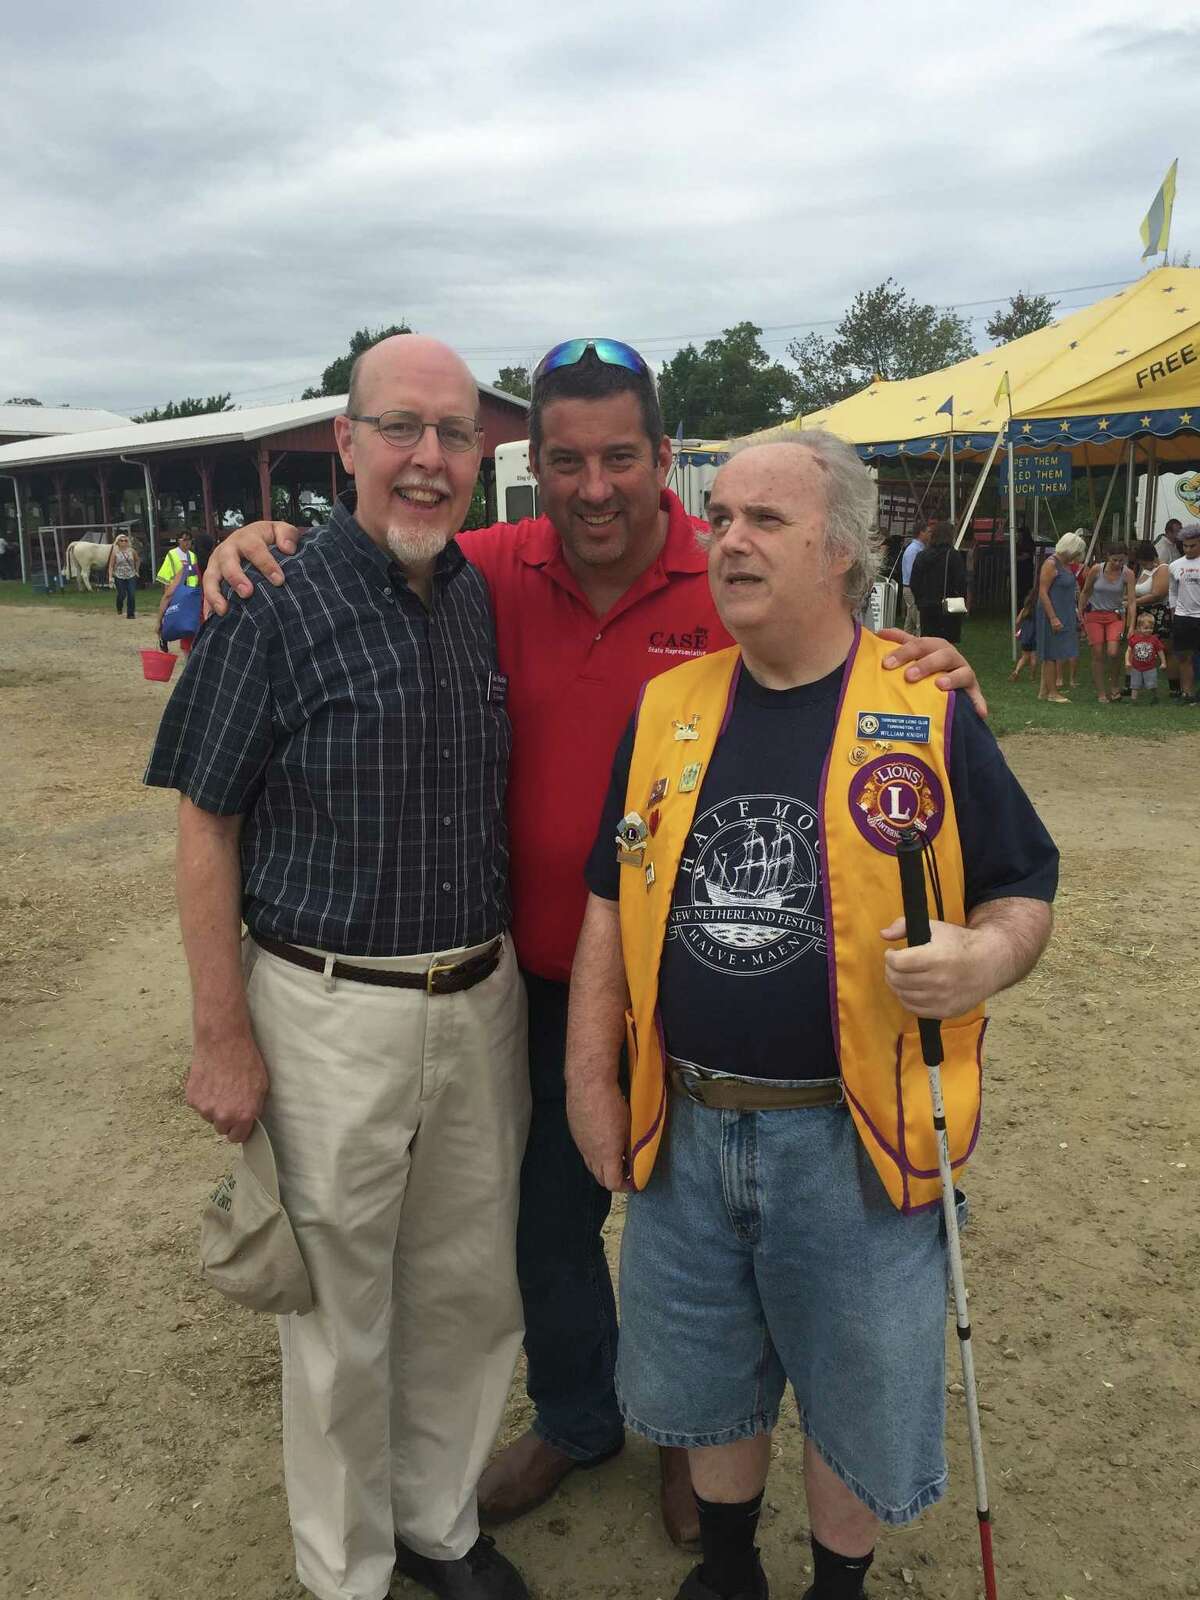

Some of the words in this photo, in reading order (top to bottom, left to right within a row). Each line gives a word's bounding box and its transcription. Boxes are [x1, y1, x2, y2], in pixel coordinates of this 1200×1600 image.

[1136, 343, 1197, 389] FREE
[1034, 456, 1058, 466] THEM
[1037, 470, 1063, 480] THEM
[1003, 484, 1035, 494] TUCH
[648, 631, 708, 649] CASE
[648, 646, 664, 654] State
[880, 730, 905, 738] WILLIAM
[877, 766, 921, 784] LIONS
[888, 787, 911, 820] L
[681, 801, 751, 873] HALF
[693, 908, 776, 922] NETHERLAND
[778, 914, 827, 936] FESTIVA
[689, 929, 738, 966] HALVE
[752, 936, 801, 966] MAEN
